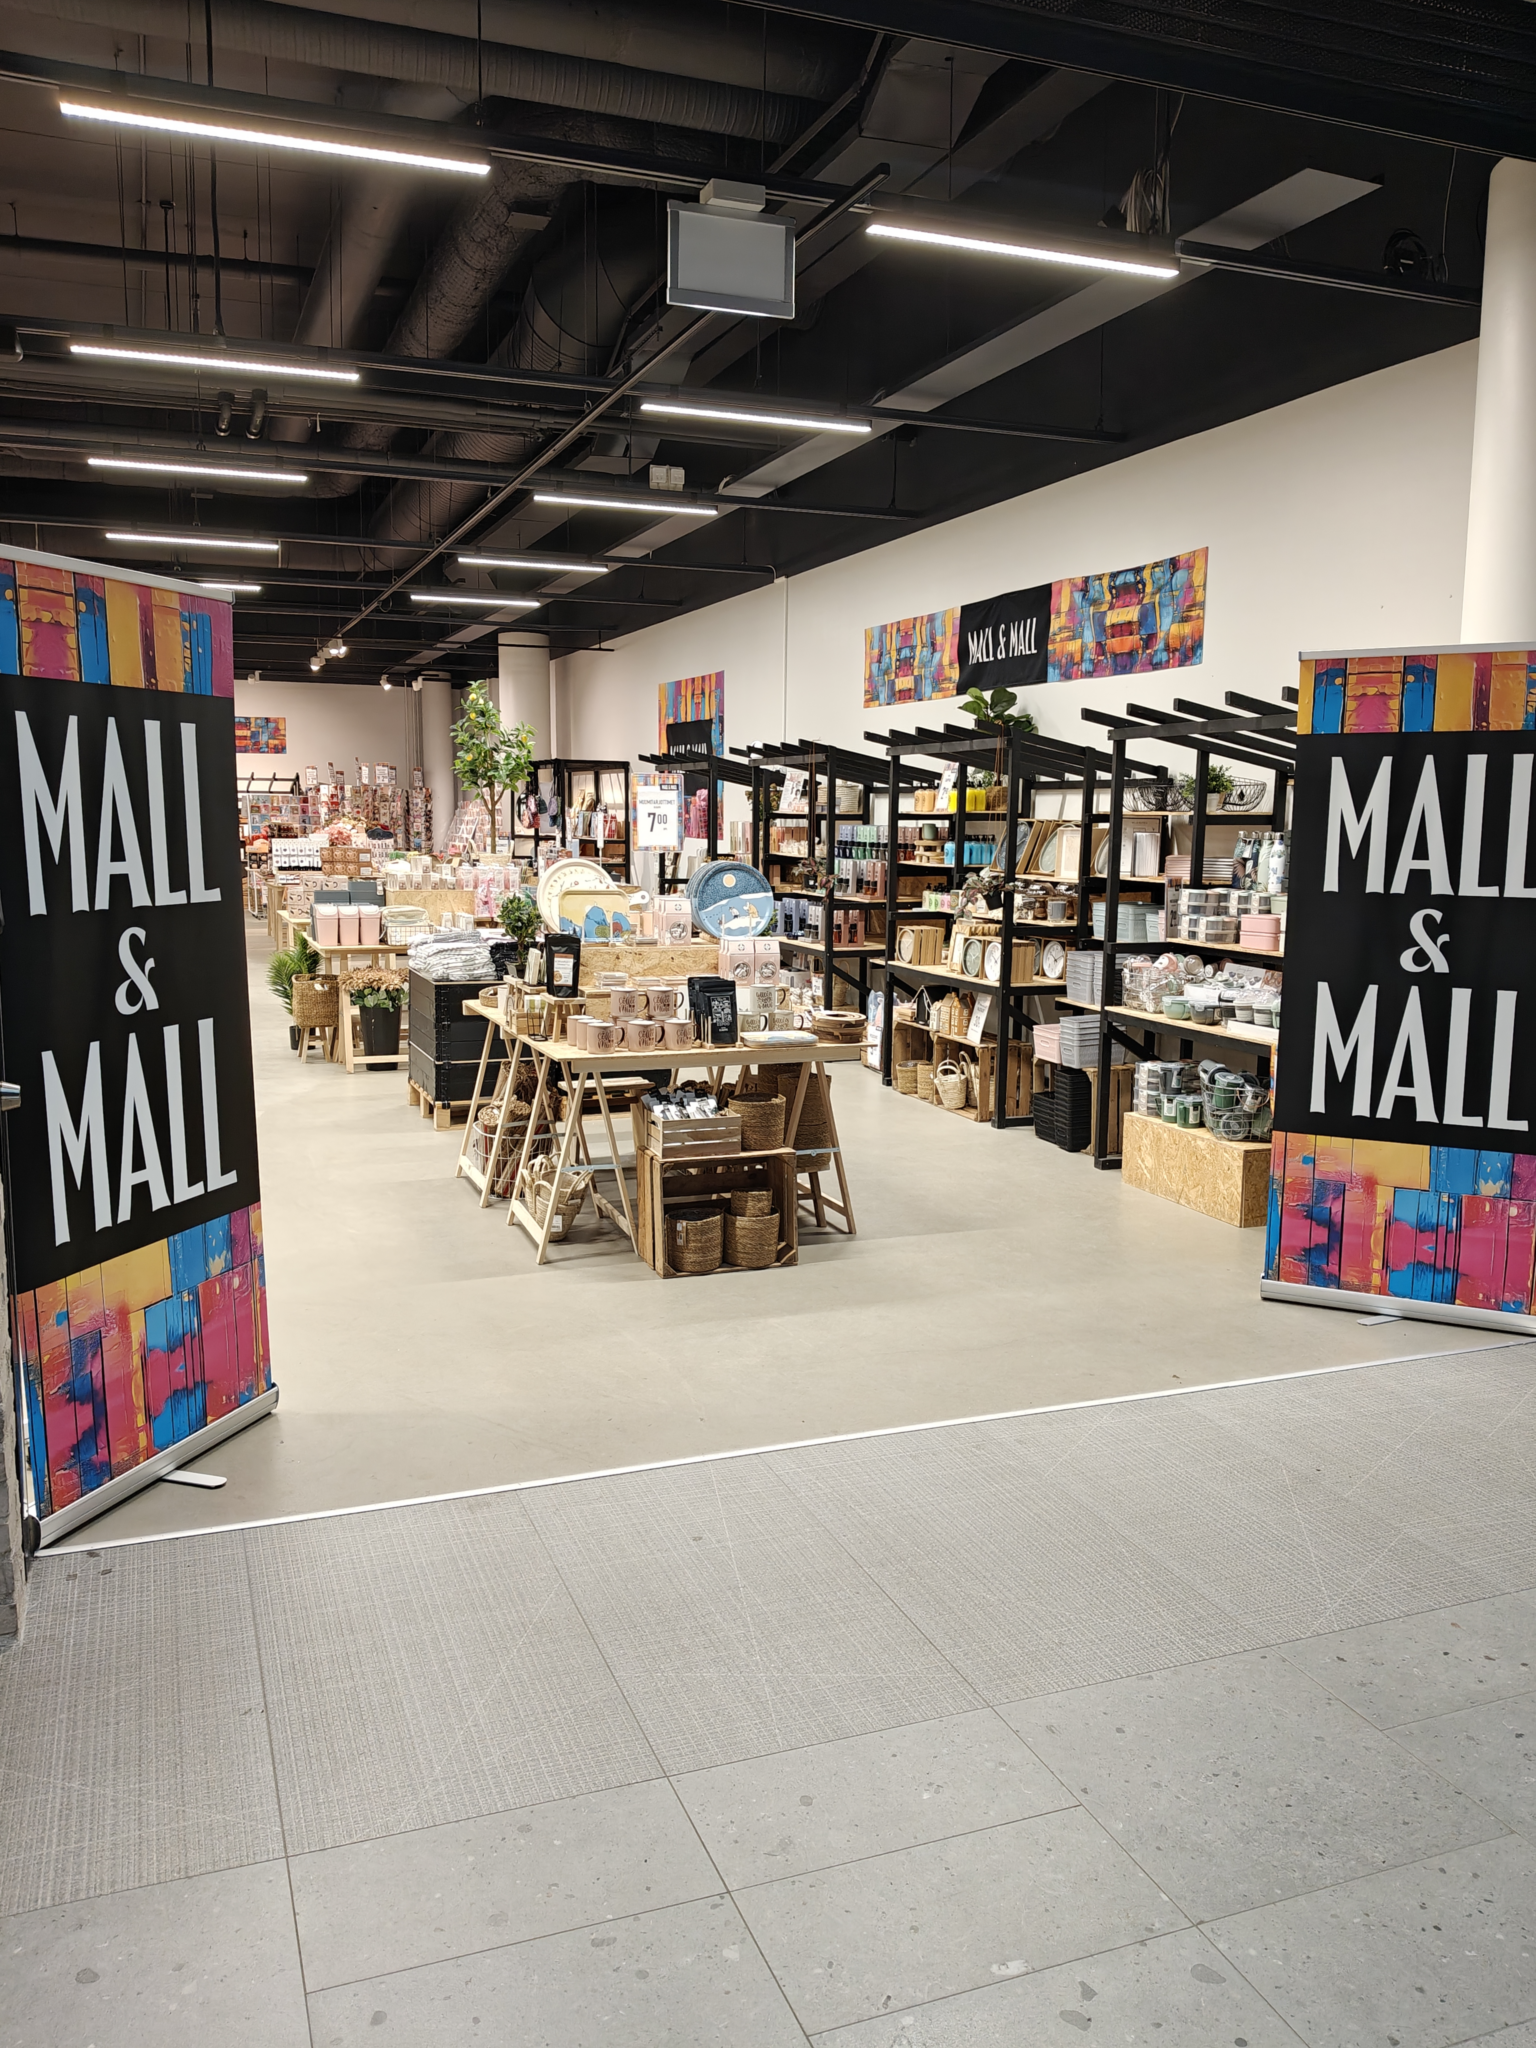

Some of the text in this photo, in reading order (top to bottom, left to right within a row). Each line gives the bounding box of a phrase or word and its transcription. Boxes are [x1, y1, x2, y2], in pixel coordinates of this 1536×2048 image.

[968, 617, 1038, 666] MALL & MALL
[15, 710, 222, 917] MALL
[1323, 753, 1536, 898] MALL
[114, 927, 160, 1016] &
[1399, 908, 1450, 974] &
[1309, 981, 1530, 1132] MALL
[41, 1018, 238, 1248] MALL
